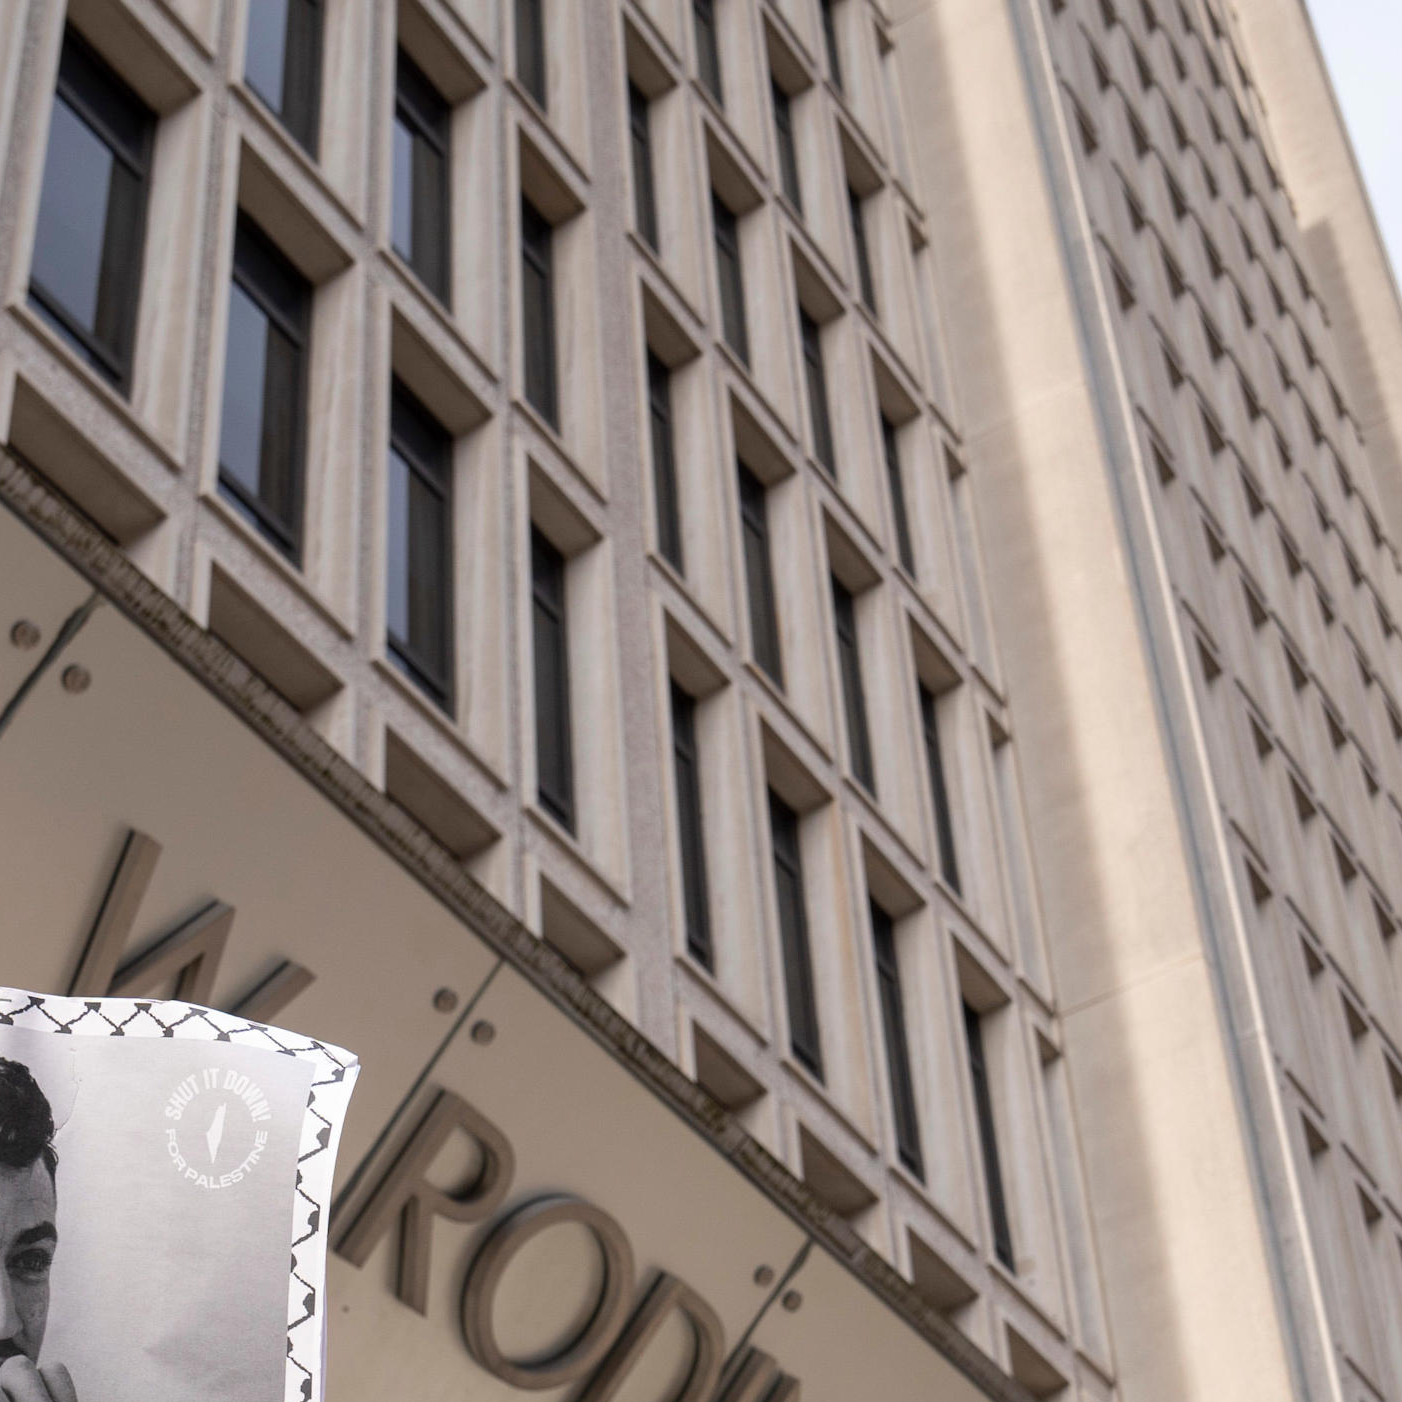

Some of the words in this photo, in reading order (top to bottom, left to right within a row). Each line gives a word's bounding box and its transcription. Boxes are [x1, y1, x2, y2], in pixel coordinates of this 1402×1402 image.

[165, 1074, 200, 1121] SHUT
[202, 1068, 220, 1089] IT
[223, 1070, 272, 1122] DOWN!
[166, 1129, 187, 1172] FOR
[184, 1130, 268, 1189] PALESTINE
